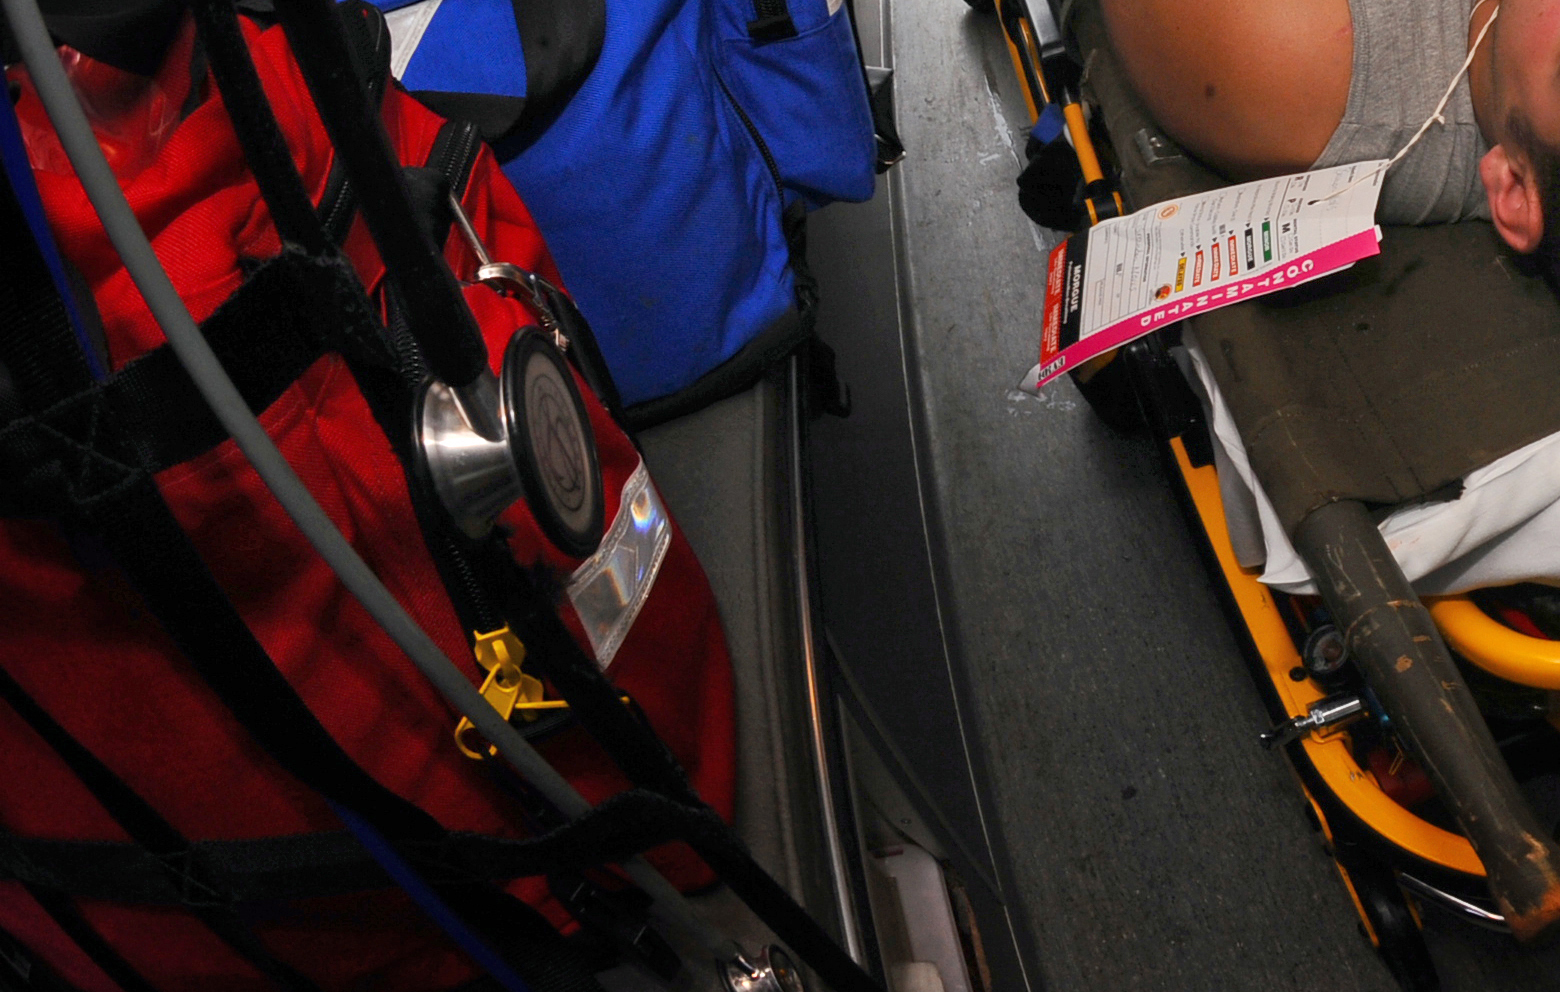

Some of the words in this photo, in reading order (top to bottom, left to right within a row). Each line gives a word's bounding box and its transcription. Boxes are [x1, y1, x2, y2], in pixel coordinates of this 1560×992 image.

[1282, 222, 1290, 234] M
[1054, 248, 1064, 296] IMMEDIATE
[1194, 254, 1202, 285] IMMEDIATE
[1212, 246, 1220, 280] IMMEDIATE
[1230, 238, 1238, 274] IMMEDIATE
[1070, 264, 1082, 313] MORGUE
[1140, 258, 1314, 327] CONTAMINATED
[1050, 302, 1060, 353] IMMEDIATE
